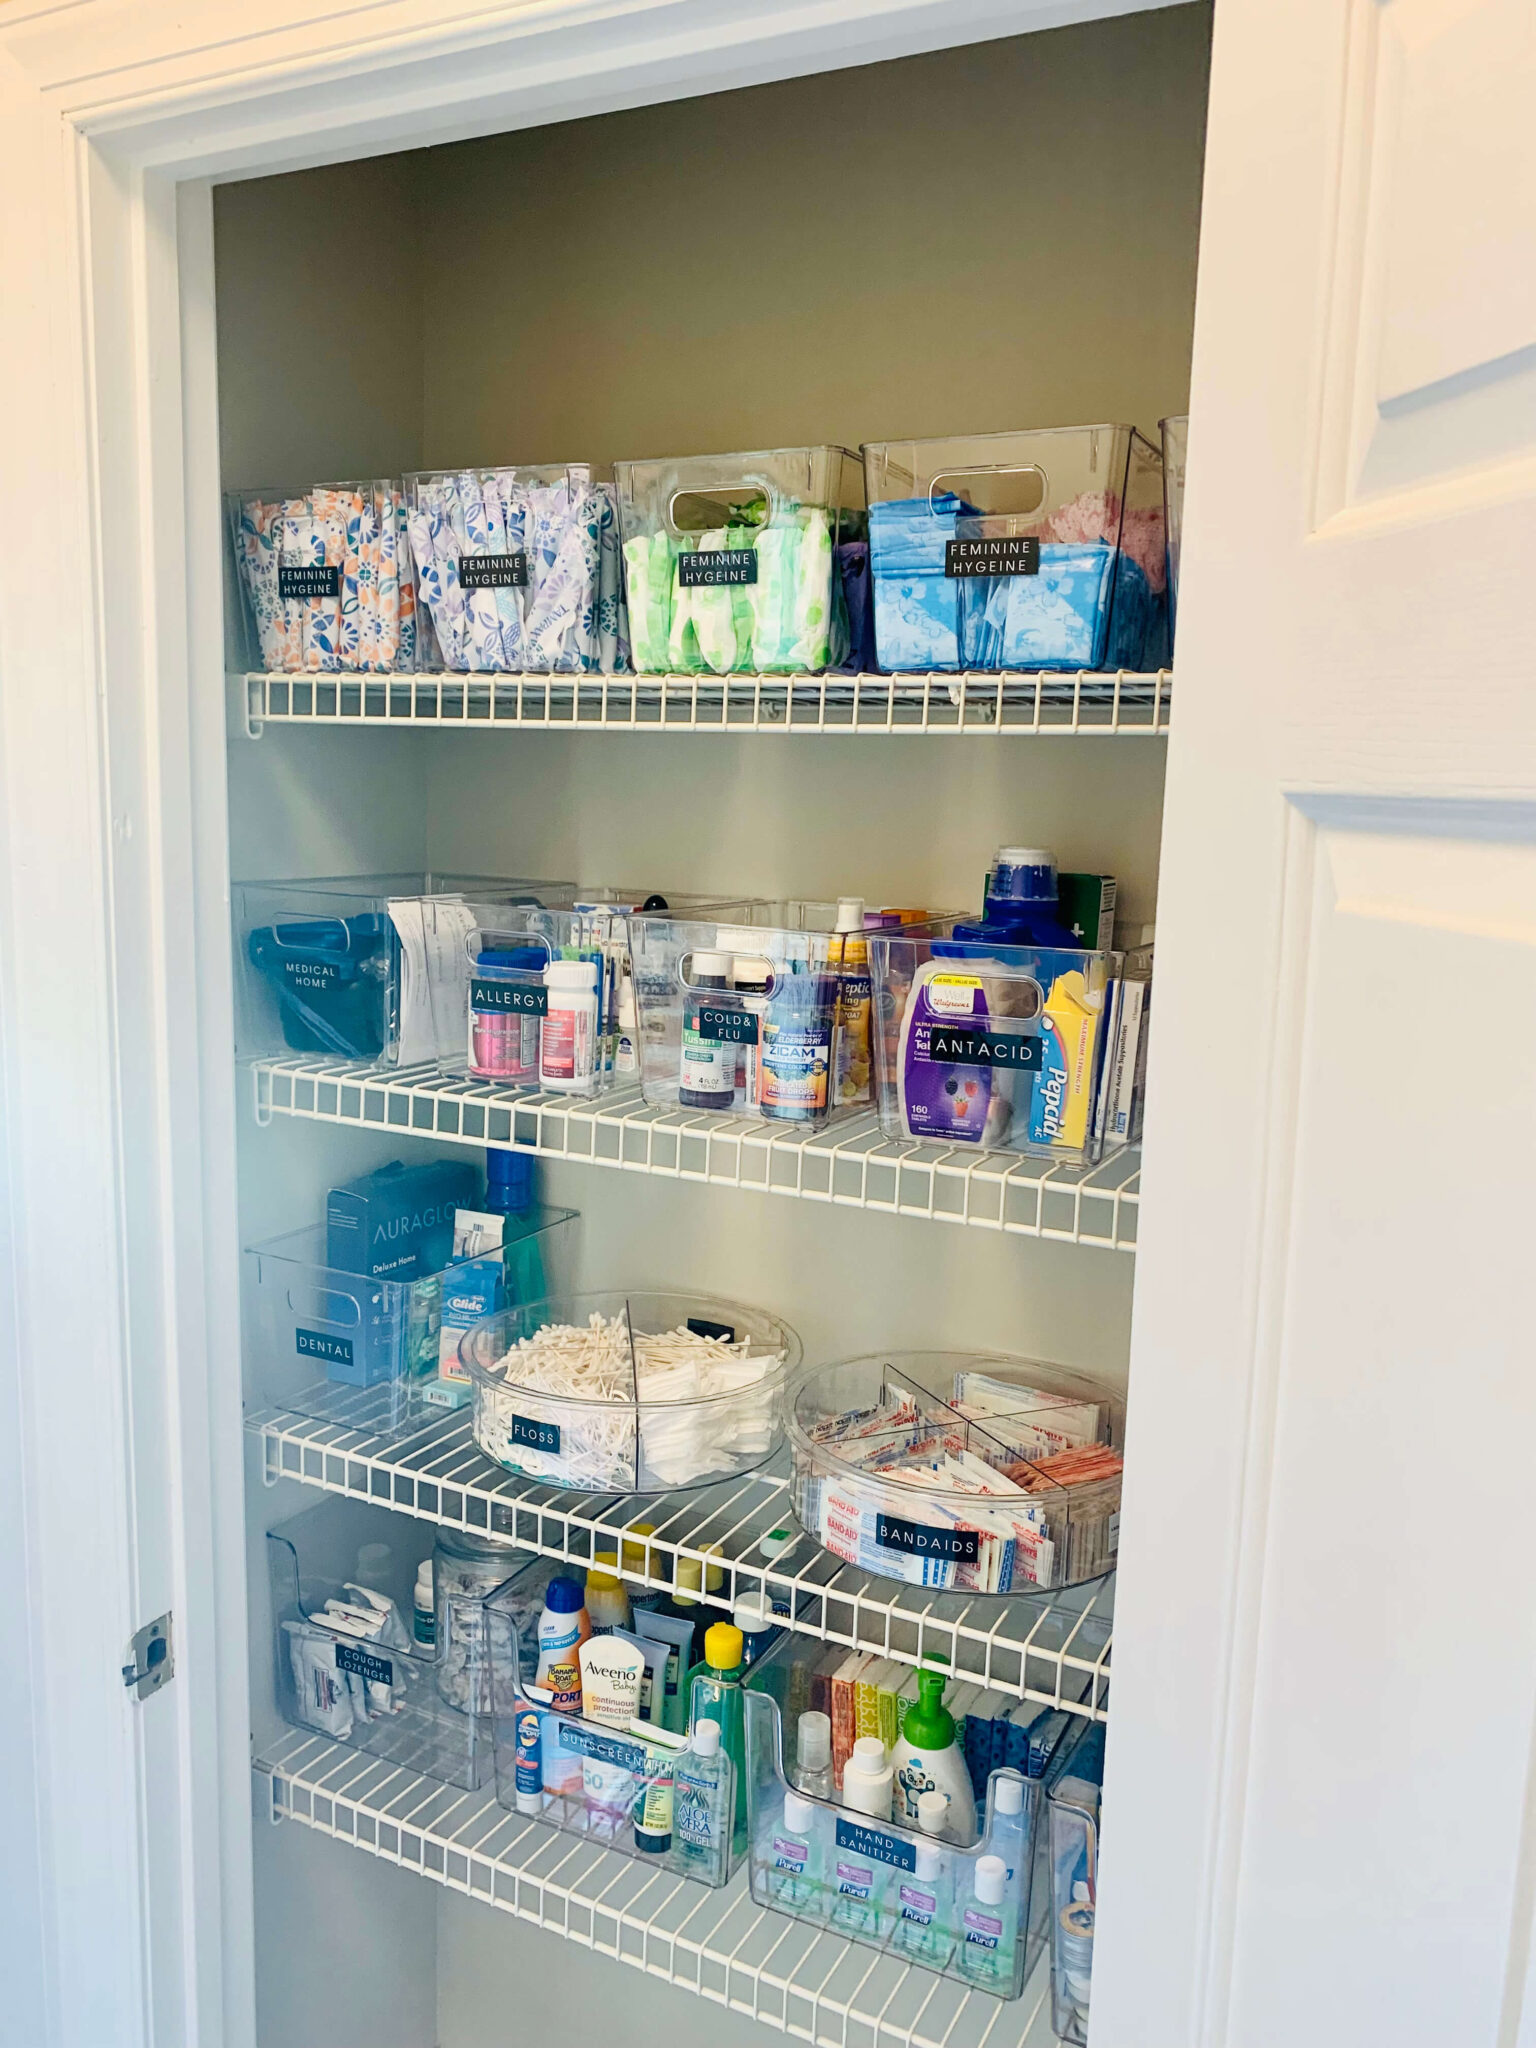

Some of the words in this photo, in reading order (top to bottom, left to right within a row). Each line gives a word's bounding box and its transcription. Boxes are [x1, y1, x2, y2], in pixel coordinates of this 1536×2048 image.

[950, 541, 1031, 557] FEMININE
[462, 557, 521, 571] FEMININE
[682, 552, 751, 568] FEMININE
[952, 559, 1027, 574] HYGEINE
[280, 569, 333, 581] FEMININE
[465, 572, 519, 586] HYGEINE
[685, 568, 748, 583] HYGEINE
[283, 583, 332, 595] HYGEINE
[530, 604, 570, 636] TAMPAX
[285, 963, 335, 978] MEDICAL
[295, 976, 327, 989] HOME
[476, 989, 544, 1008] ALLERGY
[934, 998, 970, 1008] Walgreens
[704, 1012, 741, 1025] COLD
[743, 1016, 751, 1027] &
[718, 1028, 740, 1039] FLU
[1079, 1018, 1088, 1056] MAXIMUM
[770, 1045, 816, 1058] ZICAM
[935, 1038, 1033, 1061] ANTACID
[1117, 1024, 1129, 1064] Suppositories
[1075, 1057, 1085, 1094] STRENGTH
[1115, 1065, 1124, 1087] Acetate
[768, 1085, 786, 1093] FRUIT
[788, 1087, 815, 1095] DROPS
[911, 1104, 928, 1114] 160
[1040, 1066, 1068, 1138] Pepcid
[1109, 1088, 1121, 1132] Hydrocortisone
[1034, 1125, 1043, 1138] AC
[373, 1196, 473, 1244] AURAGLOW
[373, 1262, 397, 1274] Deluxe
[398, 1254, 416, 1266] Home
[452, 1298, 483, 1312] Glide
[299, 1337, 350, 1358] DENTAL
[514, 1424, 554, 1444] FLOSS
[880, 1525, 974, 1554] BANDAIDS
[344, 1650, 382, 1667] COUGH
[338, 1659, 390, 1683] LOZENGES
[585, 1660, 636, 1681] Aveeno
[554, 1674, 573, 1684] BOAT
[610, 1680, 636, 1694] Baby
[552, 1690, 582, 1702] PORT
[591, 1695, 635, 1706] continuous
[593, 1704, 635, 1715] protection
[562, 1732, 641, 1765] SUNSCREEN
[584, 1769, 603, 1789] 50
[679, 1803, 712, 1823] ALOE
[680, 1817, 711, 1834] VERA
[696, 1836, 711, 1847] GEL
[855, 1827, 894, 1849] HAND
[839, 1836, 910, 1869] SANITIZER
